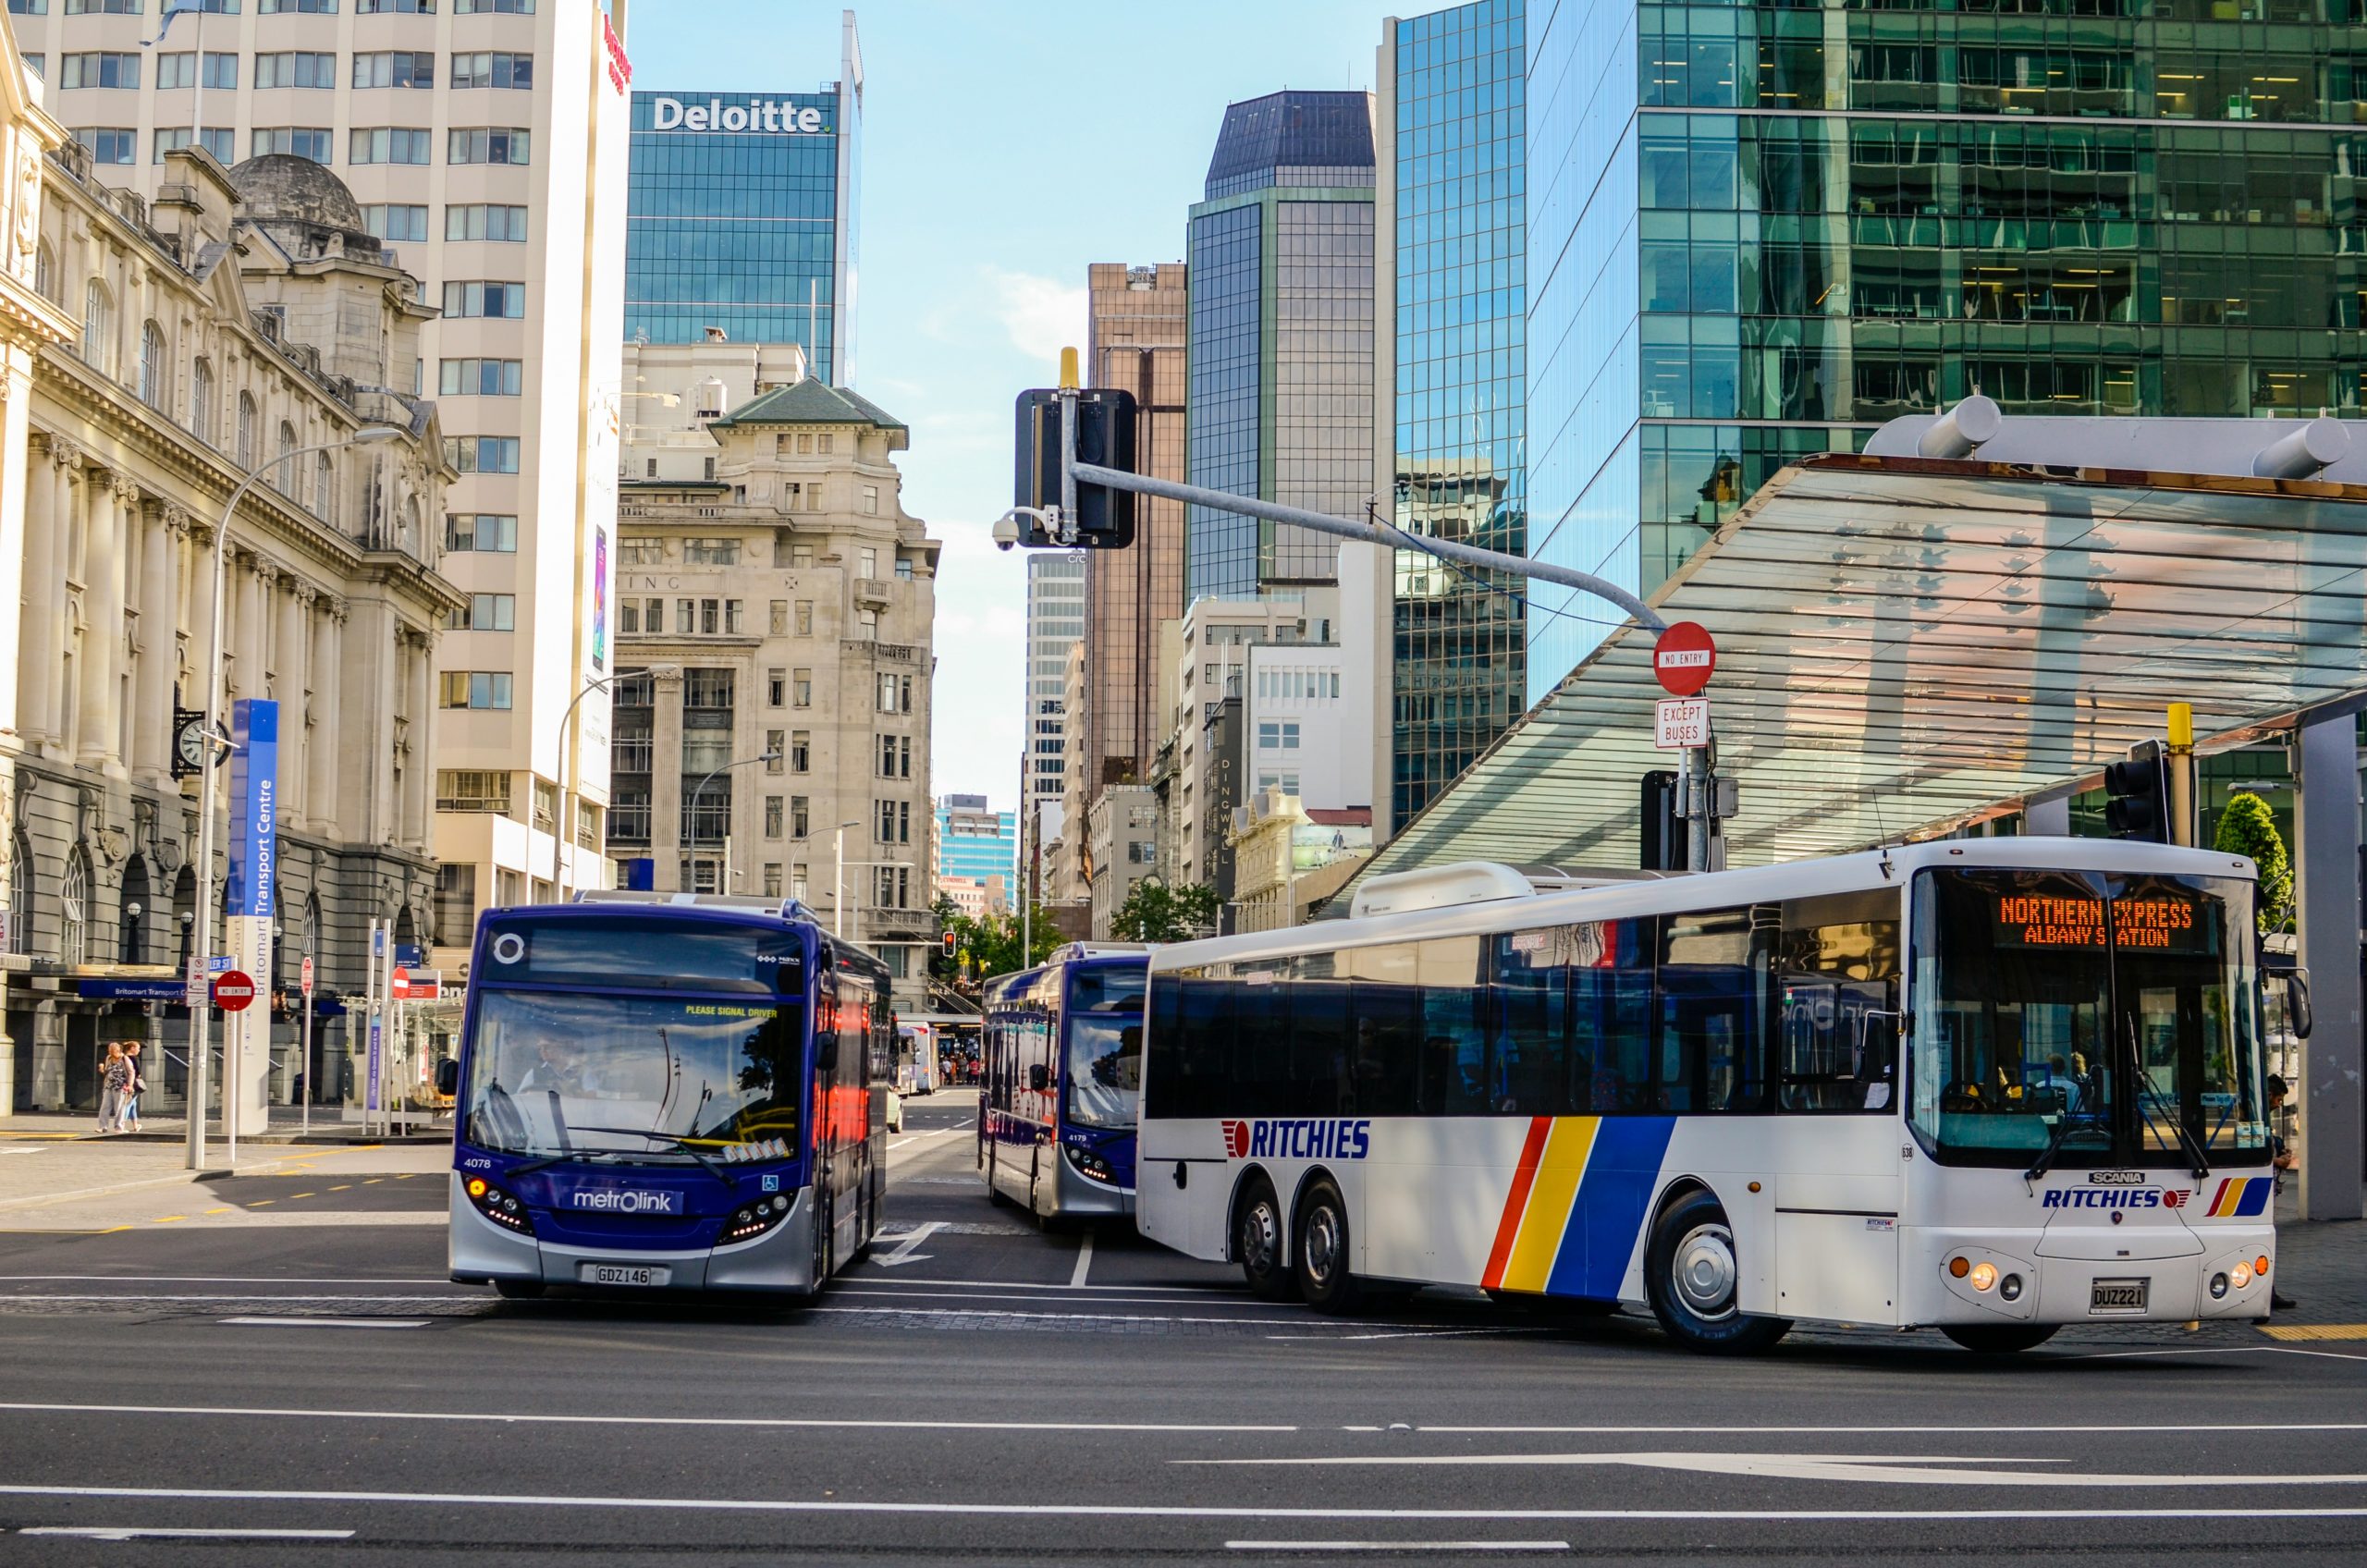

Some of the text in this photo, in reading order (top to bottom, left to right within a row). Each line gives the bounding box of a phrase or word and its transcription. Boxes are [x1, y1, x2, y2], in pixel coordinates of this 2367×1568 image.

[1665, 653, 1702, 665] NO ENTRY
[1664, 706, 1701, 721] EXCEPT
[1665, 726, 1699, 740] BUSES
[1220, 759, 1231, 864] DINGWALL
[253, 779, 272, 997] Britomart Transport Centre
[2001, 898, 2103, 925] NORTHERN
[2024, 925, 2169, 947] ALBANY SATION
[686, 1005, 778, 1018] PLEASE SIGNAL DRIVER
[1068, 1133, 1086, 1142] 4179
[1250, 1120, 1370, 1158] RITCHIES
[464, 1158, 491, 1169] 4078
[2092, 1172, 2143, 1183] SCANIA
[2042, 1189, 2161, 1207] RITCHIES
[598, 1268, 648, 1283] GDZ146
[2094, 1289, 2142, 1305] DUZ221
